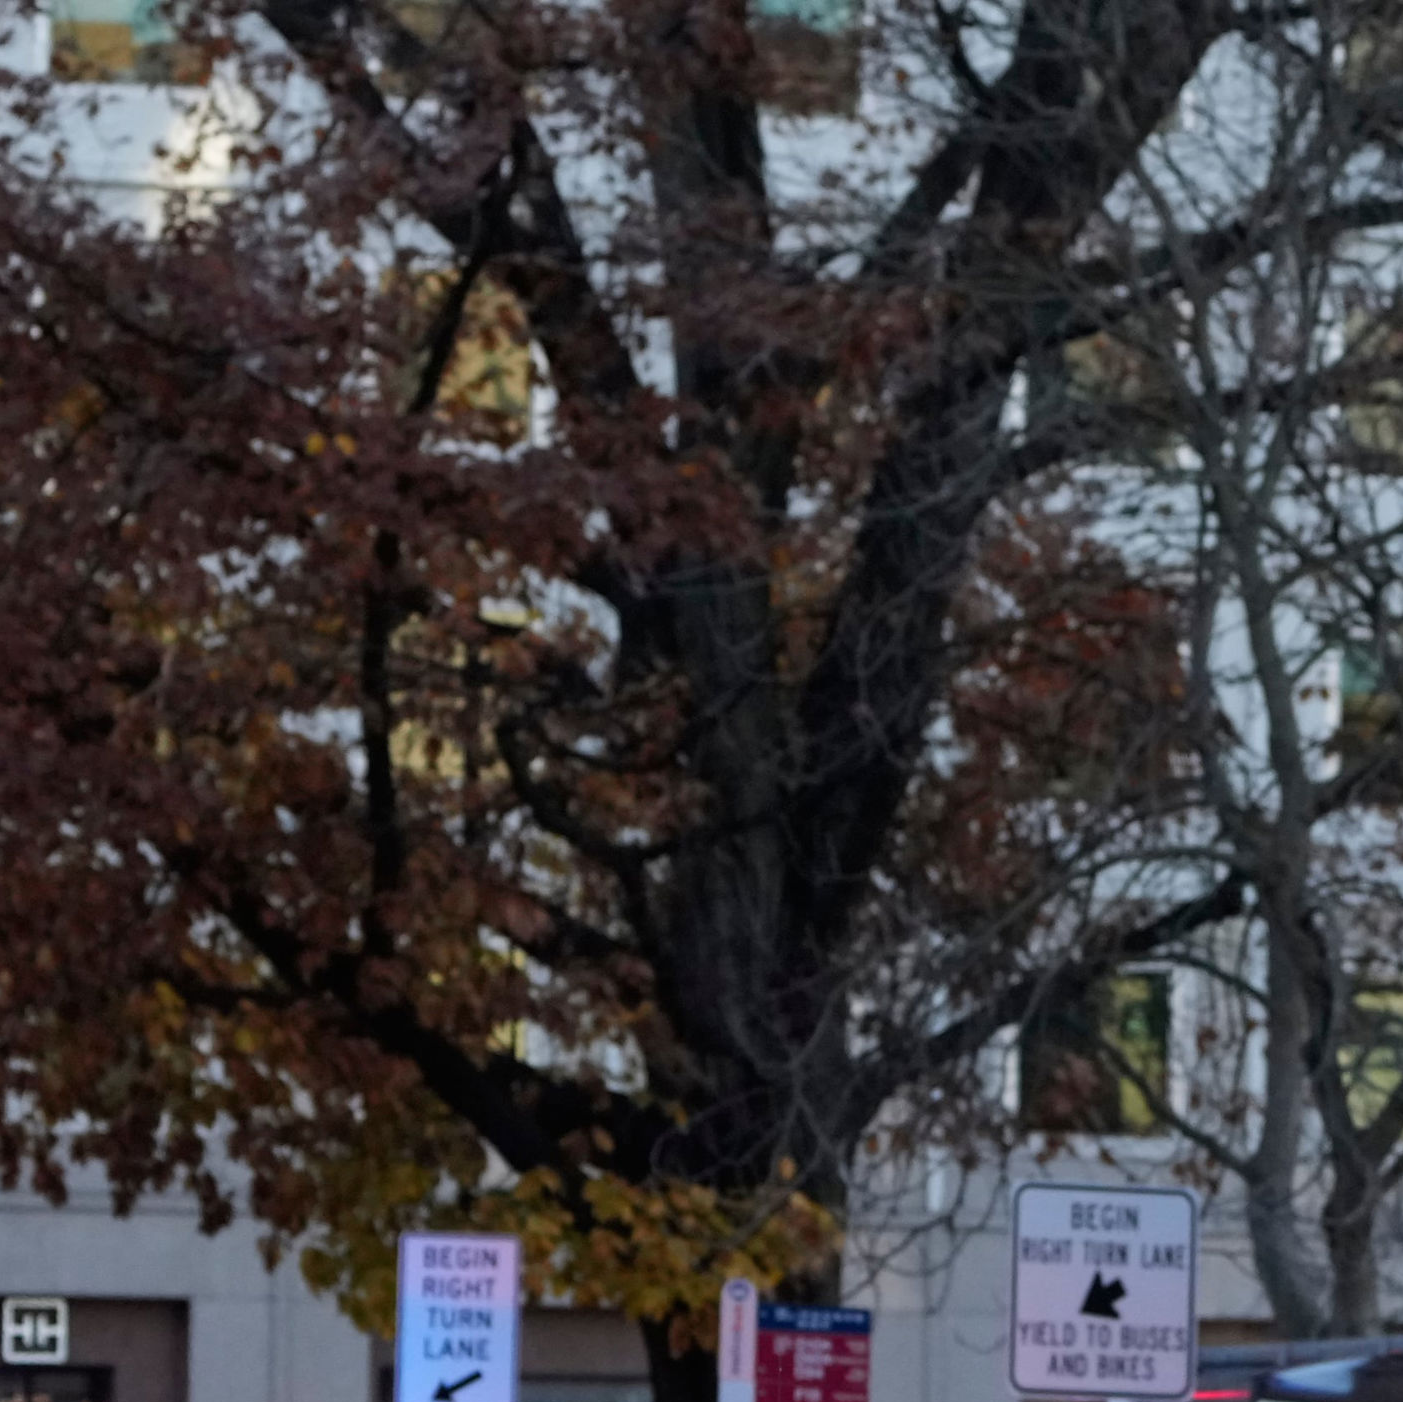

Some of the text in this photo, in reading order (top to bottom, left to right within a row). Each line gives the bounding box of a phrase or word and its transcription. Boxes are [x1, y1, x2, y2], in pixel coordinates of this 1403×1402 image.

[1070, 1203, 1140, 1231] BEGIN
[423, 1246, 498, 1269] BEGIN
[1021, 1237, 1186, 1270] RIGHT TURN LANE
[422, 1277, 495, 1299] RIGHT
[427, 1306, 492, 1329] TURN
[423, 1337, 490, 1361] LANE
[1019, 1322, 1186, 1351] YIELD TO BUSES
[1048, 1354, 1156, 1381] AND BIKES
